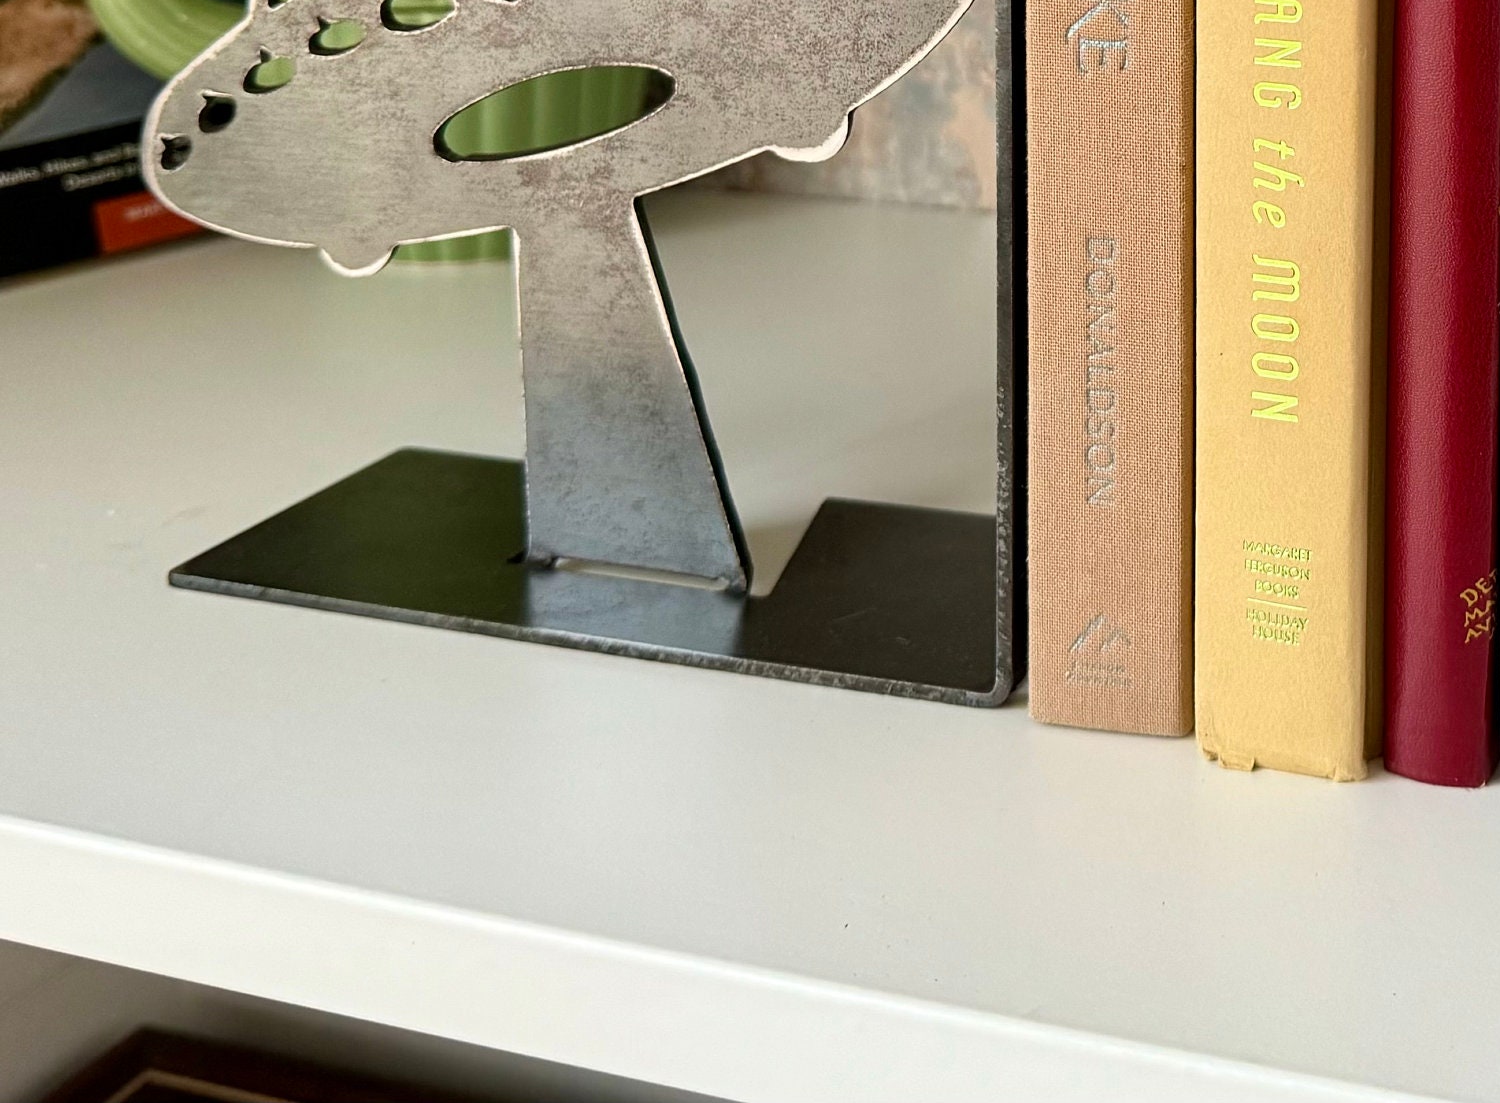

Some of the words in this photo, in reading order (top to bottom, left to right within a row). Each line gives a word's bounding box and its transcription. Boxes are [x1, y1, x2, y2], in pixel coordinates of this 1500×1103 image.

[1252, 137, 1305, 228] the
[1251, 253, 1300, 423] MOON
[1086, 237, 1118, 506] DONALDSON
[1242, 539, 1312, 561] MARGARET
[1244, 558, 1311, 580] FERGUSON
[1254, 579, 1299, 599] BOOKS
[1245, 607, 1309, 630] HOLIDAY
[1252, 624, 1300, 646] HOUSE
